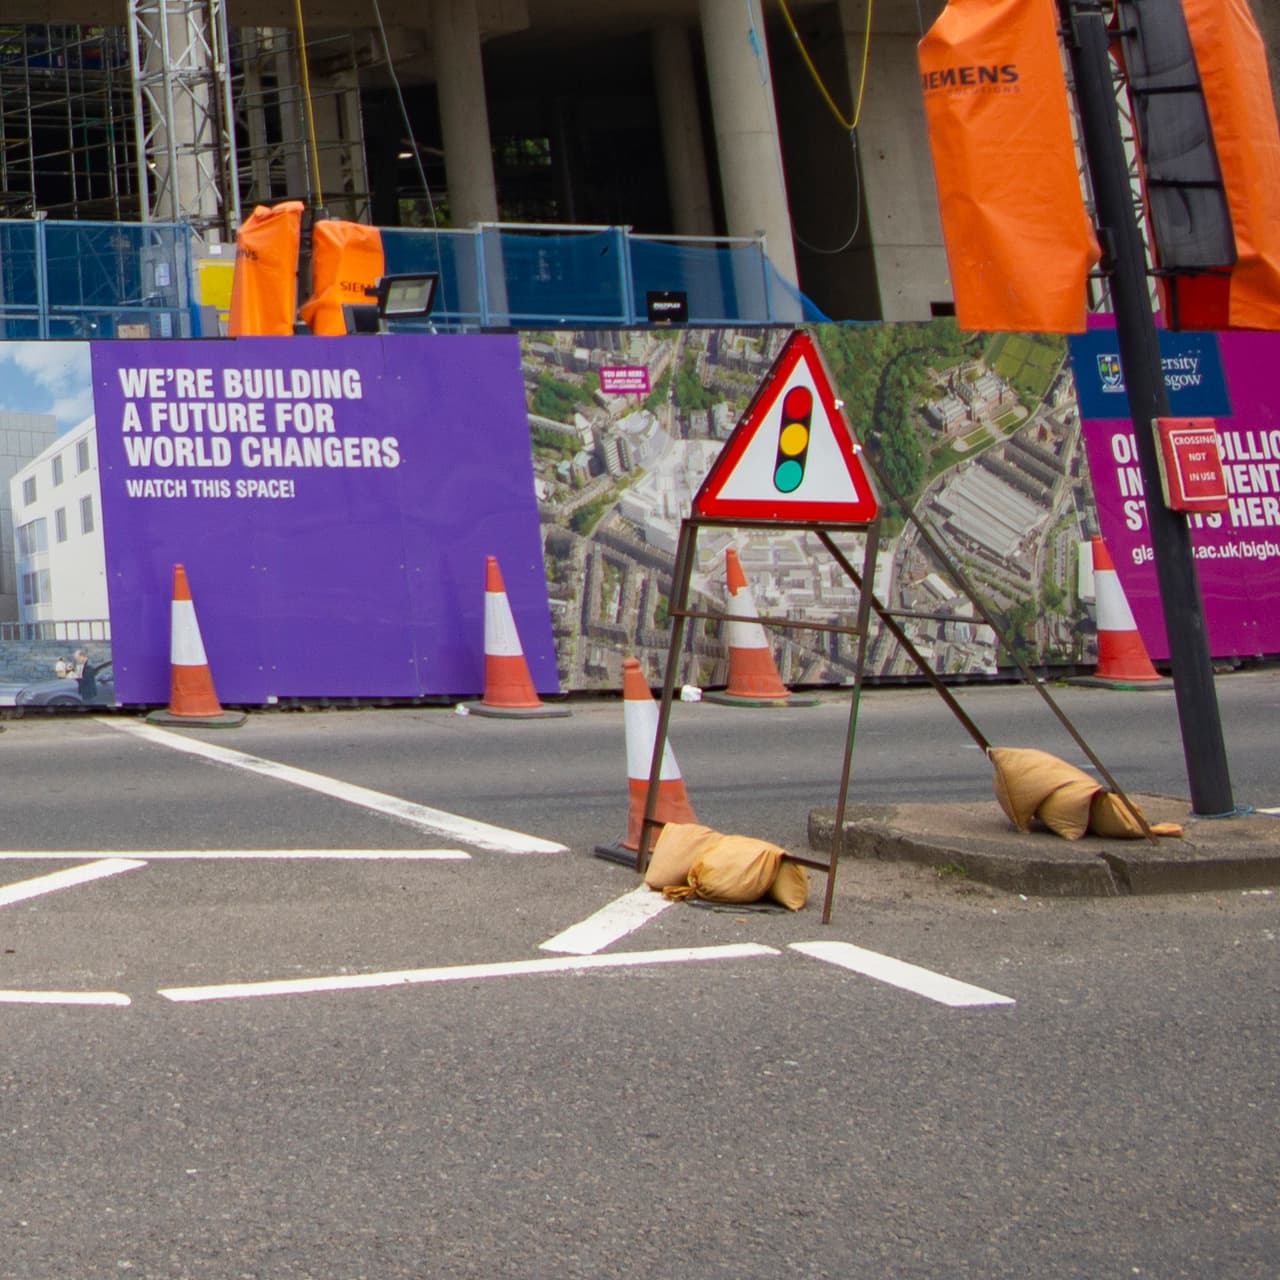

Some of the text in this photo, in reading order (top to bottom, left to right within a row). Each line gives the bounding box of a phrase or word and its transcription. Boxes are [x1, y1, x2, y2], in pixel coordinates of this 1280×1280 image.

[922, 64, 1019, 90] IEMENS
[1160, 353, 1198, 374] ersity
[118, 368, 363, 400] WE'RE BUILDING
[1163, 373, 1202, 391] sgow
[122, 402, 336, 433] A FUTURE FOR
[1174, 435, 1216, 446] CROSSING
[123, 436, 401, 468] WORLD CHANGERS
[1188, 452, 1207, 462] NOT
[1189, 472, 1216, 482] IN USE
[126, 479, 296, 498] WATCH THIS SPACE!
[1227, 496, 1280, 528] HER
